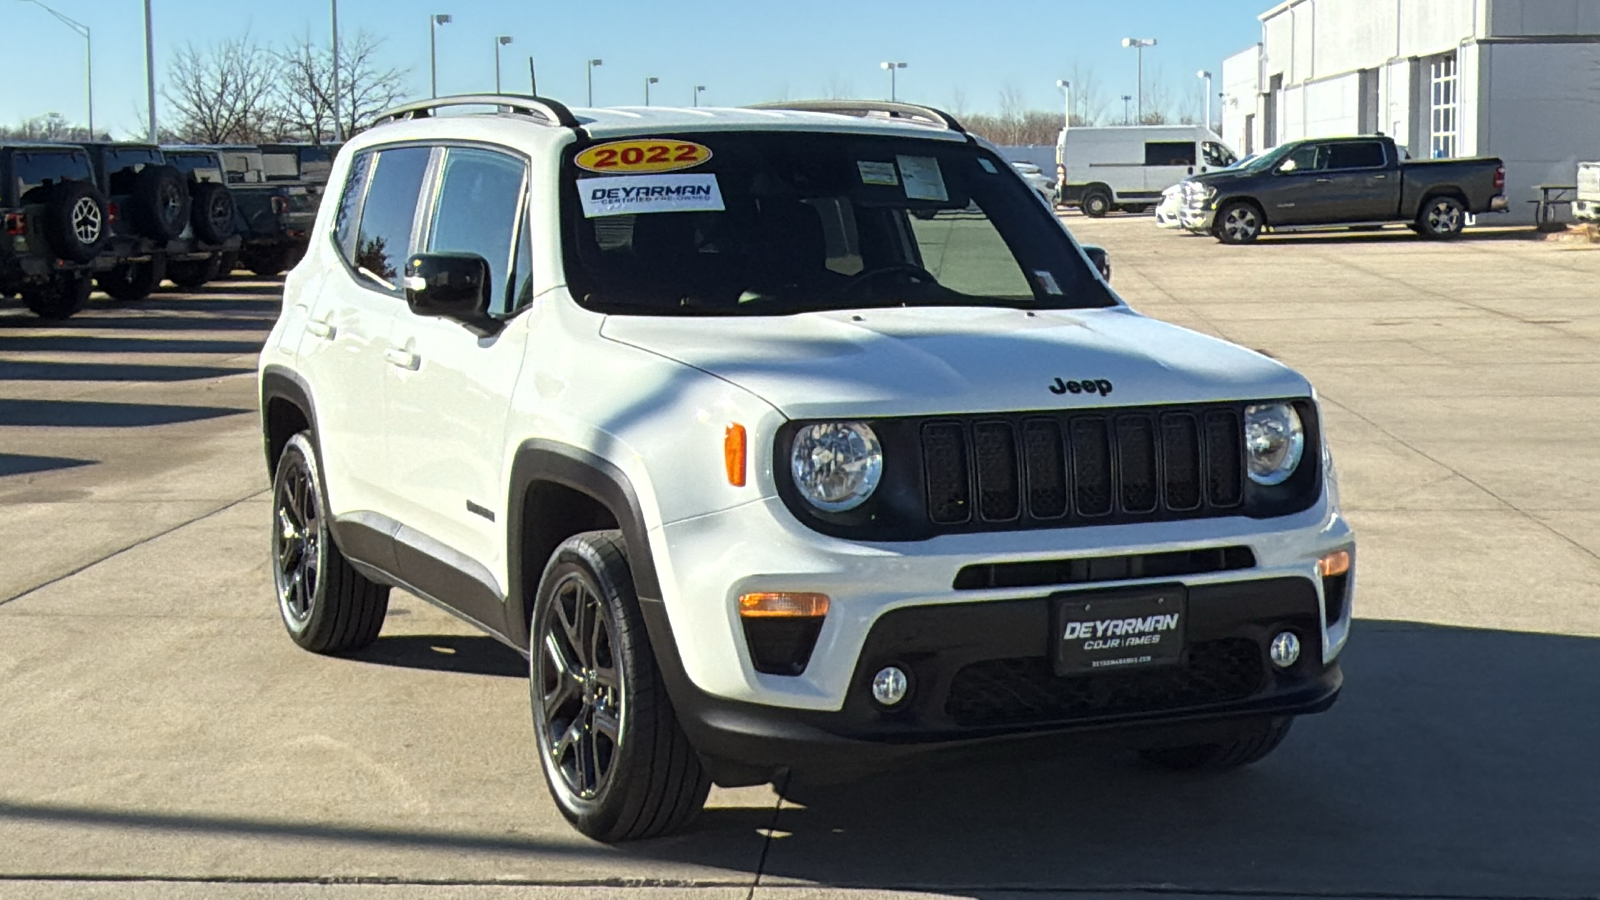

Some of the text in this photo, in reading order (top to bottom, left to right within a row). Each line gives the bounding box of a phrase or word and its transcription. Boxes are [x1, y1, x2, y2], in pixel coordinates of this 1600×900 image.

[593, 144, 698, 168] 2022
[591, 185, 711, 200] DEYARMAN
[1048, 377, 1113, 397] Jeep
[1063, 613, 1180, 640] DEYARMAN
[1083, 634, 1161, 651] CDJR AMES
